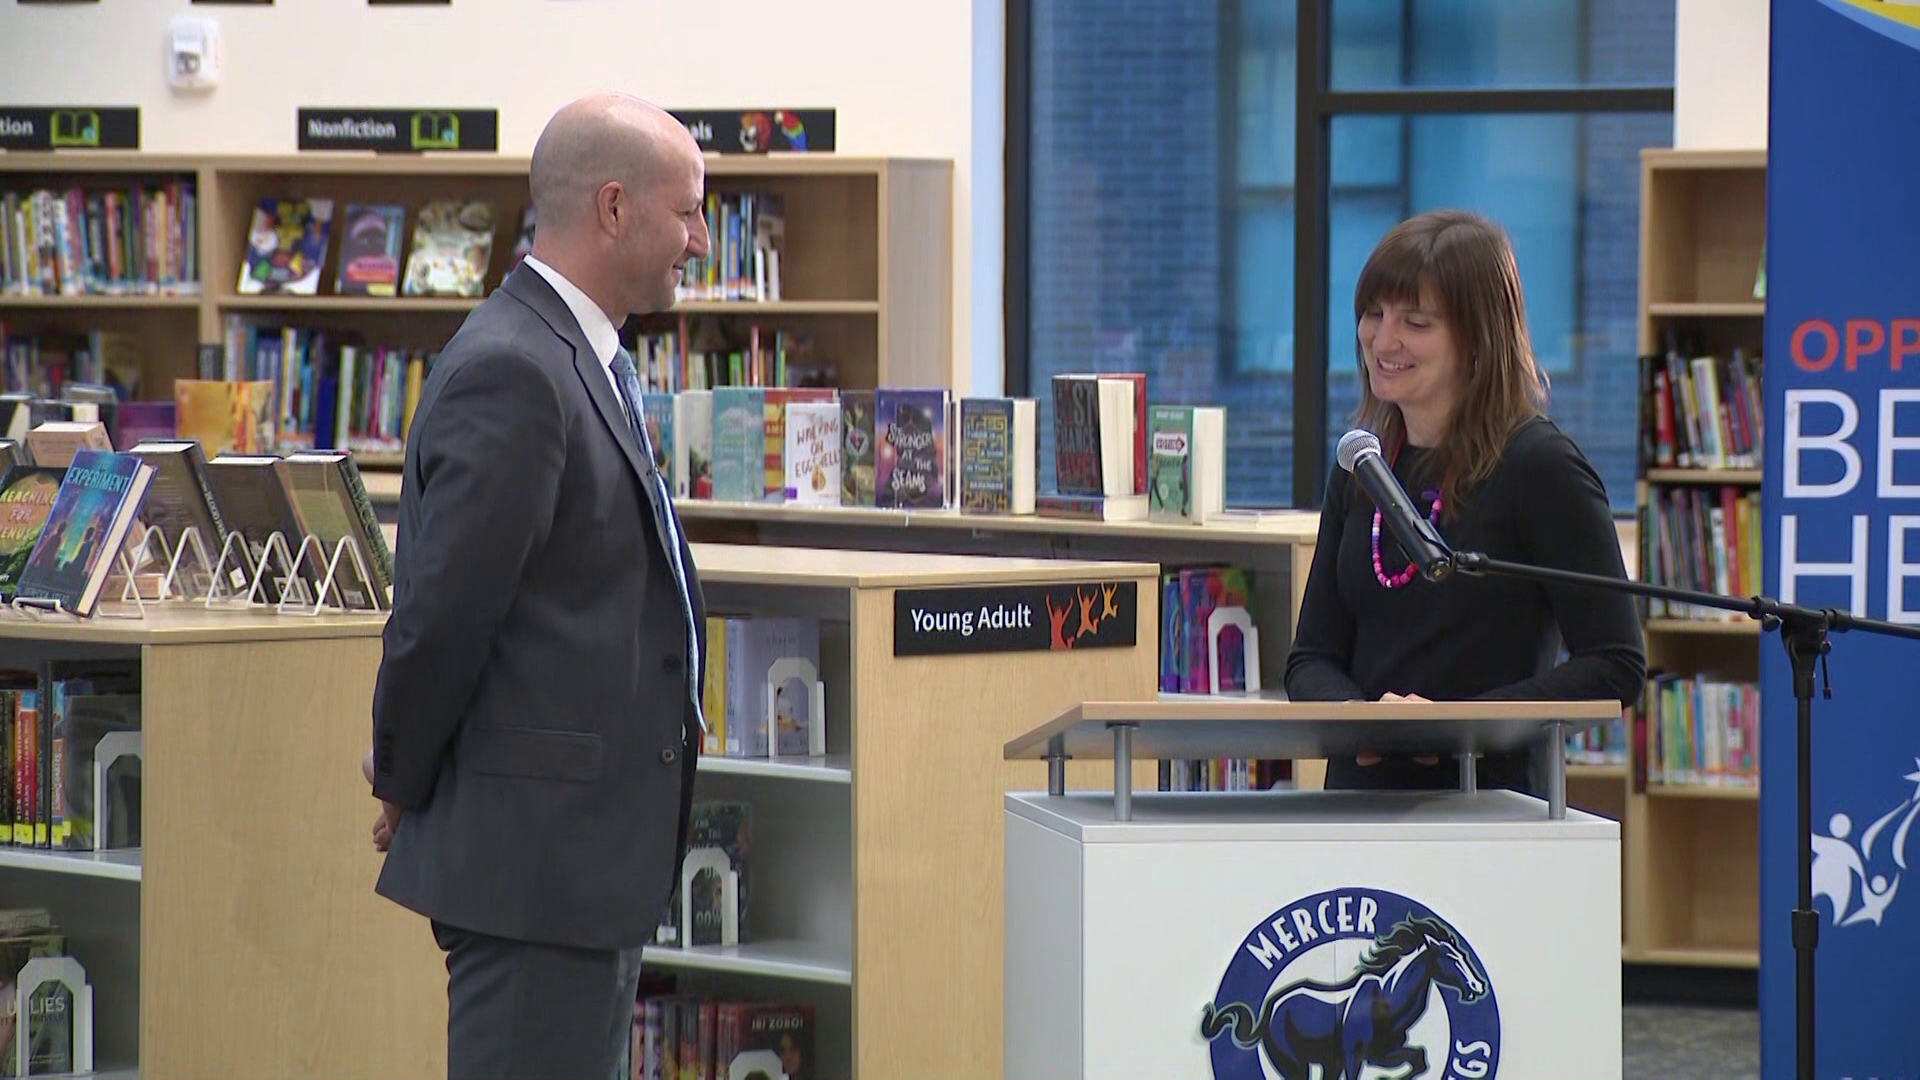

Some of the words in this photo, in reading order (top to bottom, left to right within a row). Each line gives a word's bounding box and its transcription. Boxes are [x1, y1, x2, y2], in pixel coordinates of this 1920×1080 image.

[308, 117, 396, 138] Nonfiction
[1789, 317, 1920, 372] OPP
[902, 449, 913, 460] AT
[1782, 388, 1920, 498] BE
[66, 467, 130, 494] EXPERIMENT
[891, 467, 927, 493] SEAMS
[916, 457, 932, 472] THE
[1779, 514, 1920, 625] HE
[911, 608, 974, 636] Young
[977, 603, 1032, 629] Adult
[1245, 896, 1379, 971] MERCER
[1448, 1039, 1491, 1080] GS
